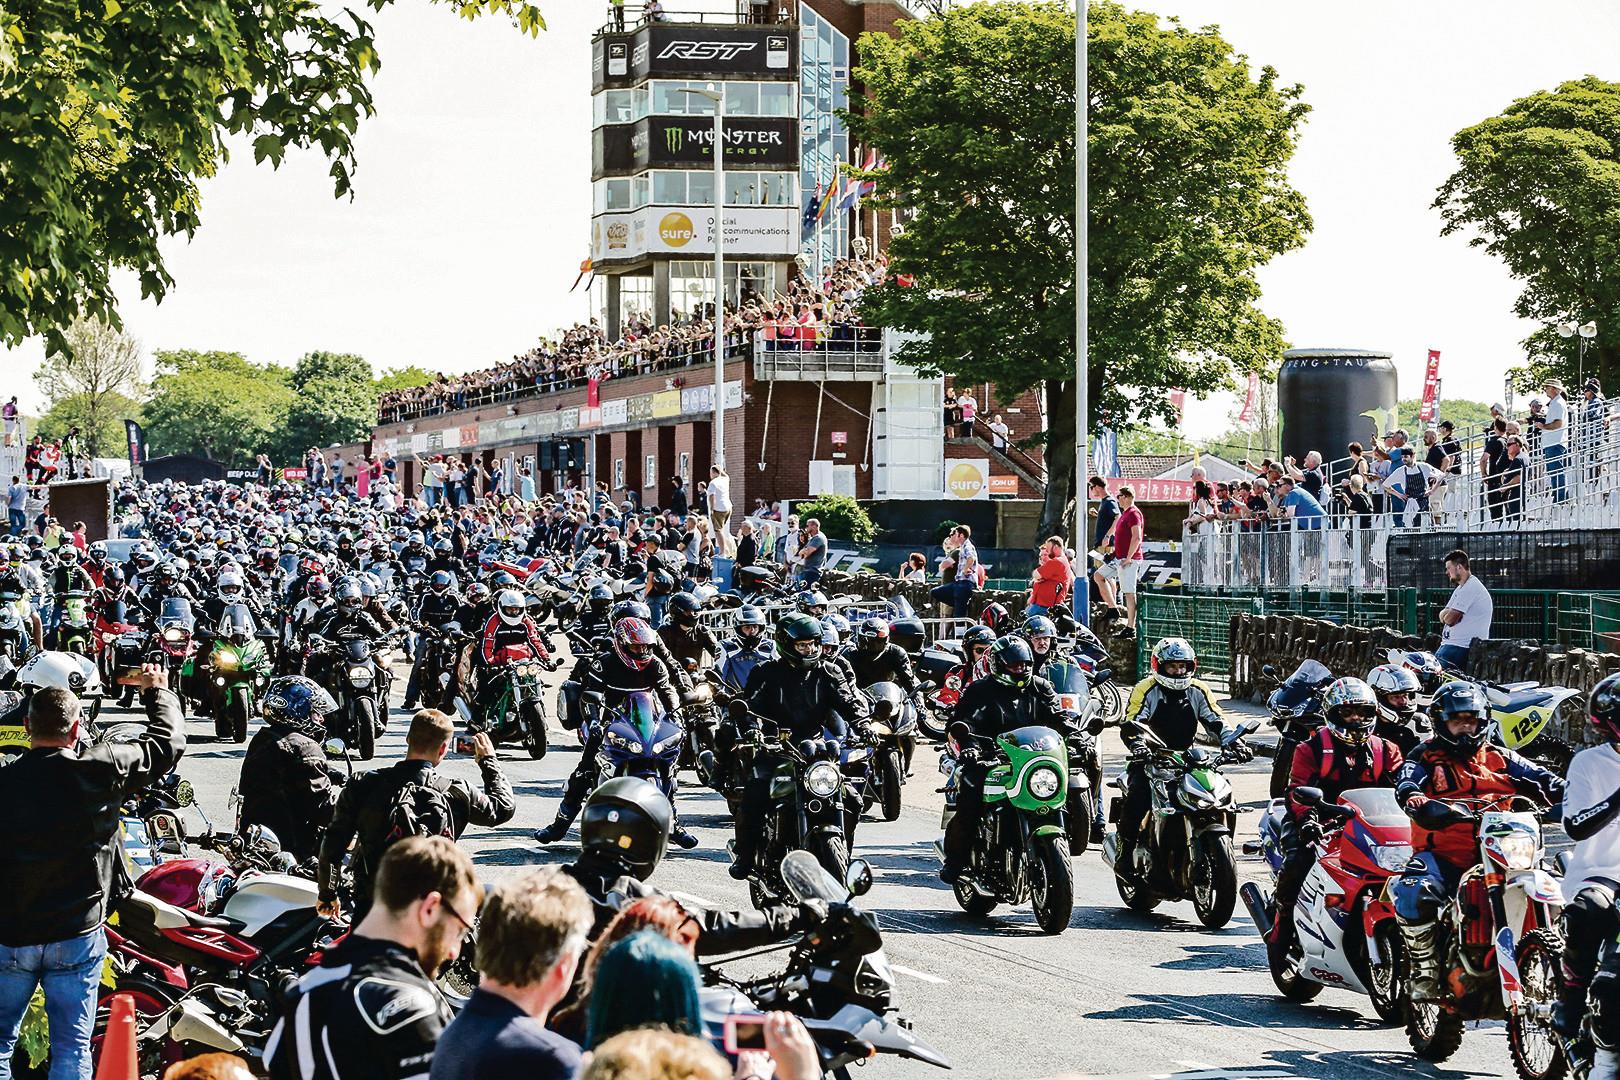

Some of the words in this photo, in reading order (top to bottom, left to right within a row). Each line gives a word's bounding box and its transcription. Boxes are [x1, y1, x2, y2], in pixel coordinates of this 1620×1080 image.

[656, 41, 758, 60] RST
[687, 127, 783, 145] MONSTER
[702, 147, 769, 155] EERGY
[707, 217, 737, 226] Ocial
[707, 226, 791, 236] Tecommunications
[707, 236, 739, 244] Pner
[825, 549, 880, 575] TT
[1511, 710, 1543, 742] 129
